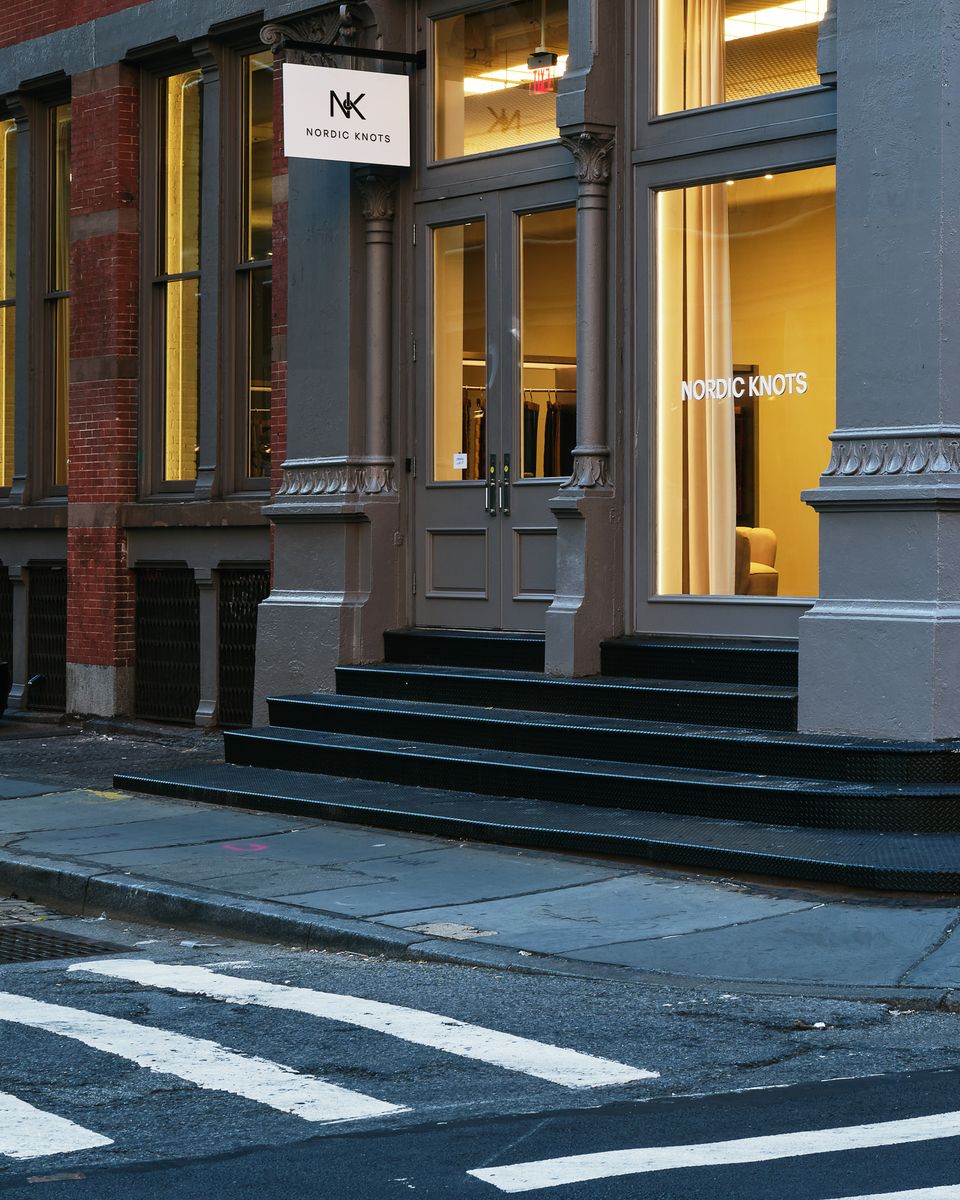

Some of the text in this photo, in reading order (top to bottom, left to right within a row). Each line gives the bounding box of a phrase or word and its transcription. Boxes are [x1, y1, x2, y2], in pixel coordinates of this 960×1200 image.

[306, 127, 392, 144] NORDIC KNOTS
[681, 372, 808, 401] NORDIC KNOTS
